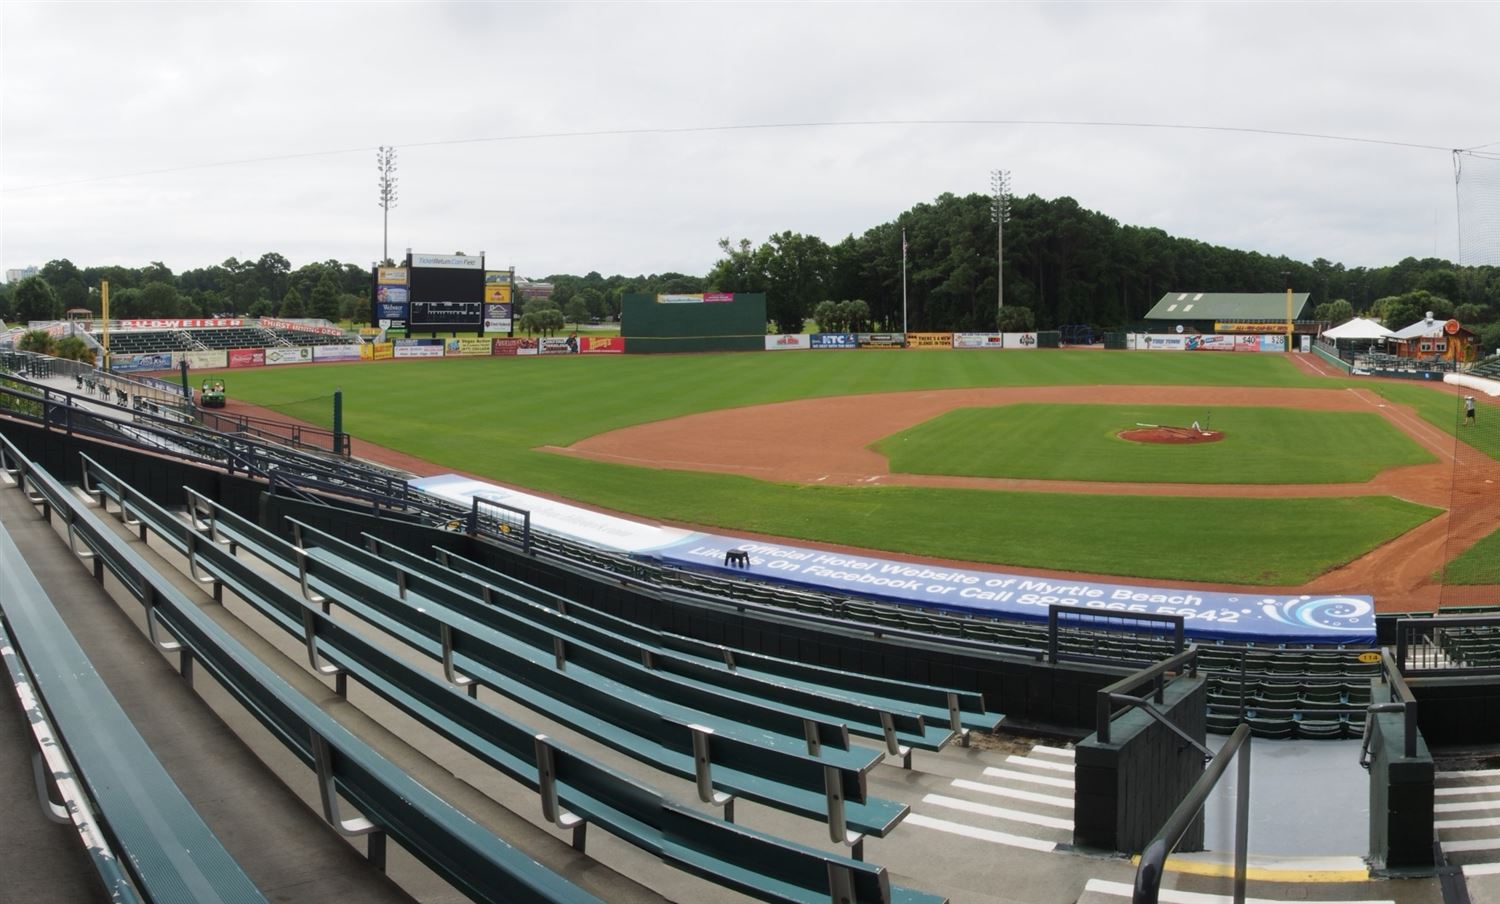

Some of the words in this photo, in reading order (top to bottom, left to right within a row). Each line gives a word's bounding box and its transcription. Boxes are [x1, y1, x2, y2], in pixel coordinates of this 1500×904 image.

[263, 319, 291, 329] THIRST
[737, 543, 815, 561] Official
[812, 555, 879, 571] Hotel
[880, 564, 980, 584] Website
[985, 579, 1017, 588] of
[1018, 581, 1104, 597] Myrtle
[1112, 589, 1202, 606] Beach
[768, 560, 801, 571] On
[801, 565, 924, 590] Facebook
[926, 585, 957, 594] or
[960, 587, 1014, 602] Call
[1156, 606, 1240, 623] 5642
